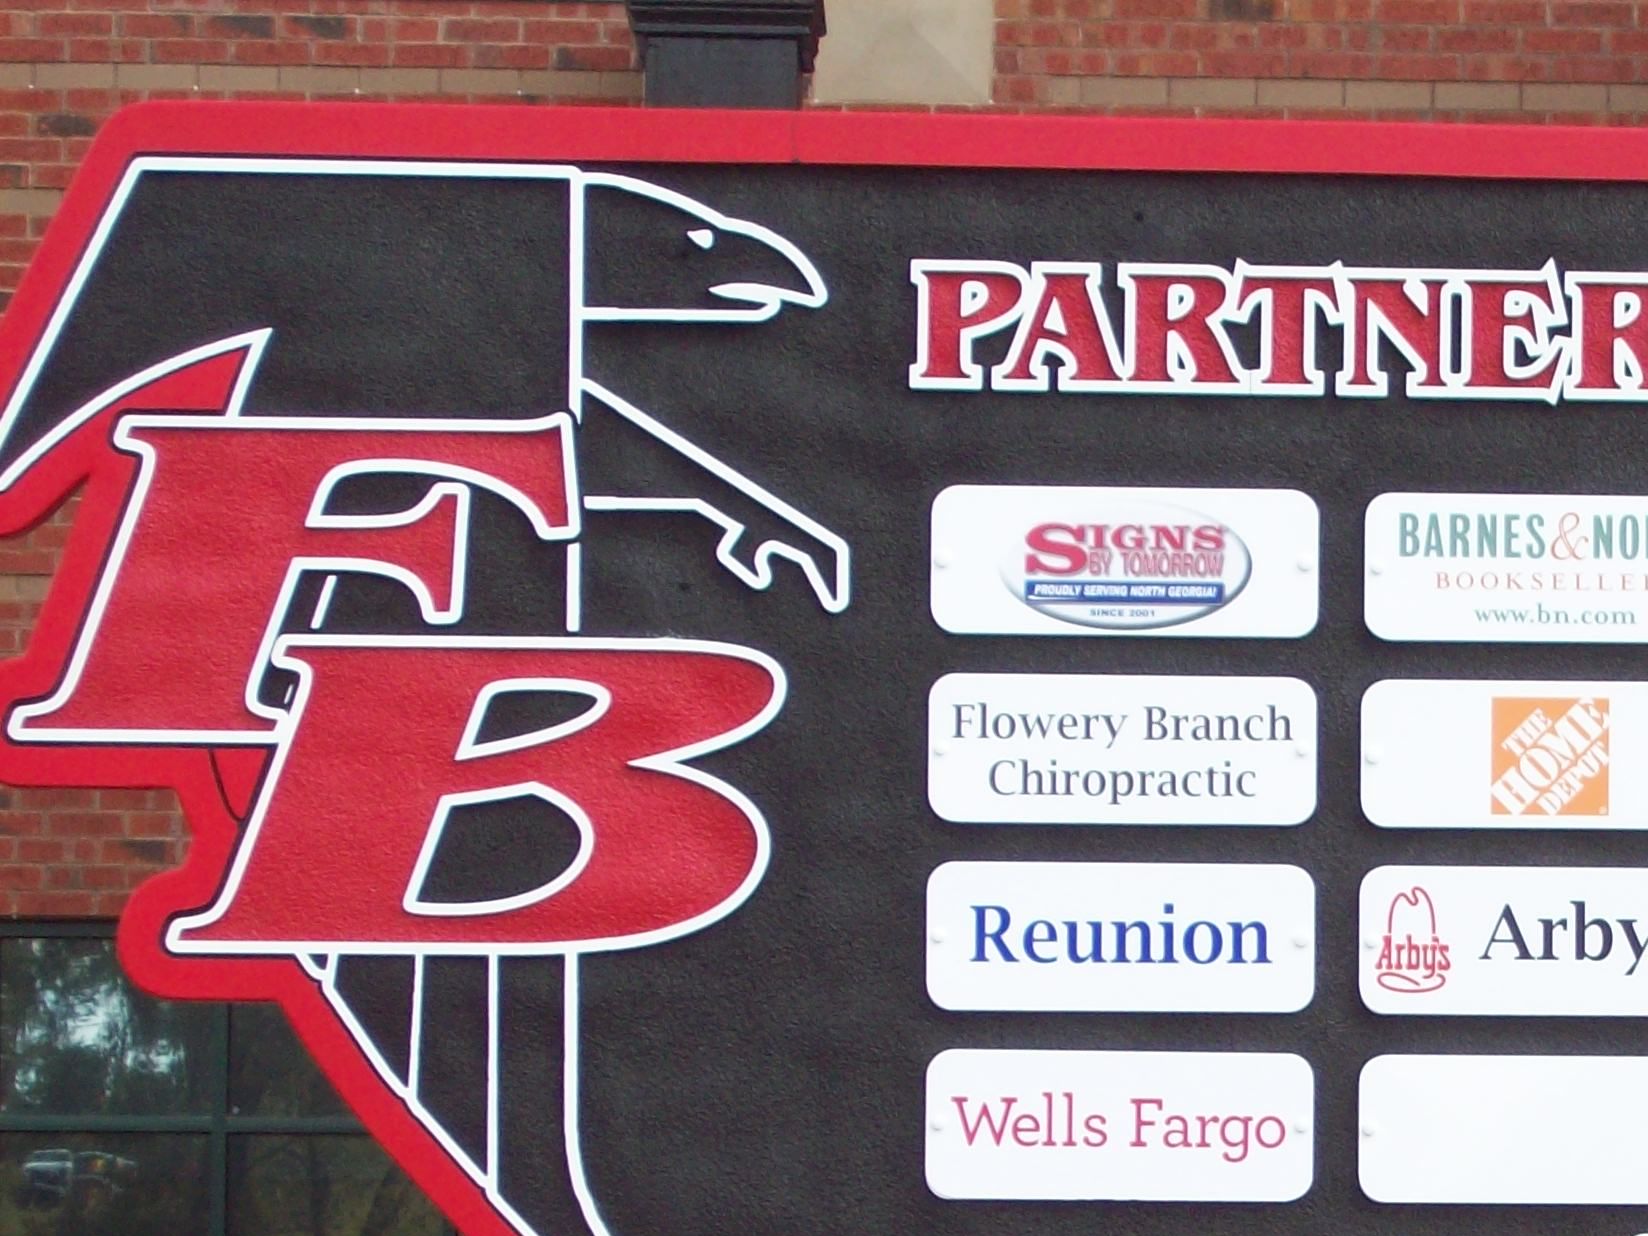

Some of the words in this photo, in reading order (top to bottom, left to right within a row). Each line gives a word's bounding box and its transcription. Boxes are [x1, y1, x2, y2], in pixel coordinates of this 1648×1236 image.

[1025, 522, 1225, 576] SIGNS
[1089, 552, 1111, 576] BY
[1122, 552, 1224, 577] TOMORROW
[1034, 583, 1081, 596] PROUDLY
[1083, 584, 1128, 597] SERVING
[1130, 585, 1166, 597] NORTH
[1090, 608, 1124, 617] SINCE
[1474, 602, 1638, 627] www.bn.com
[952, 702, 1127, 747] Flowery
[1144, 705, 1293, 744] Branch
[1501, 707, 1552, 757] THE
[1491, 698, 1609, 815] HOME
[1536, 740, 1609, 815] DEPOT
[988, 758, 1257, 806] Chiropractic
[970, 903, 1273, 966] Reunion
[1375, 933, 1452, 980] Arby's
[952, 1091, 1108, 1148] Wells
[1129, 1098, 1286, 1163] Fargo
